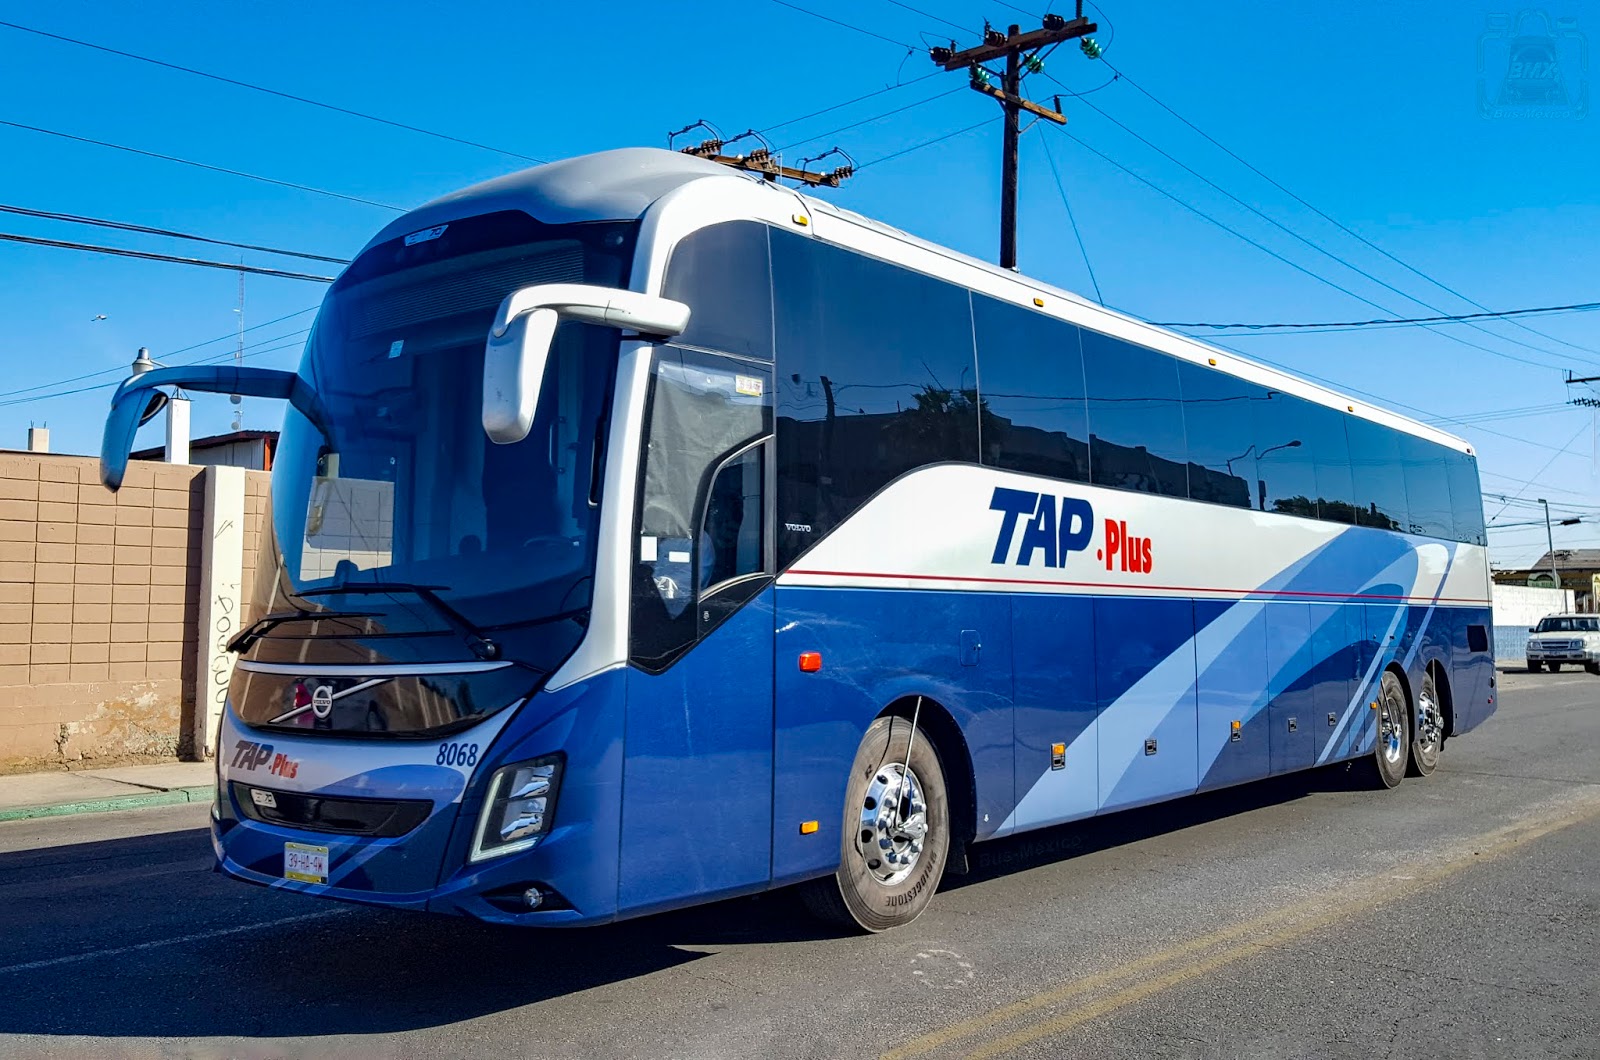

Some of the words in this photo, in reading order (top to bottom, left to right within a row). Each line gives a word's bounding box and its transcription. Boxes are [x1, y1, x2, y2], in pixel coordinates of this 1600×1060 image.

[785, 523, 811, 533] VOLVO
[989, 486, 1094, 569] TAP
[231, 740, 274, 771] TAP
[436, 742, 479, 768] 8068
[885, 851, 938, 907] BRIDGESTONE
